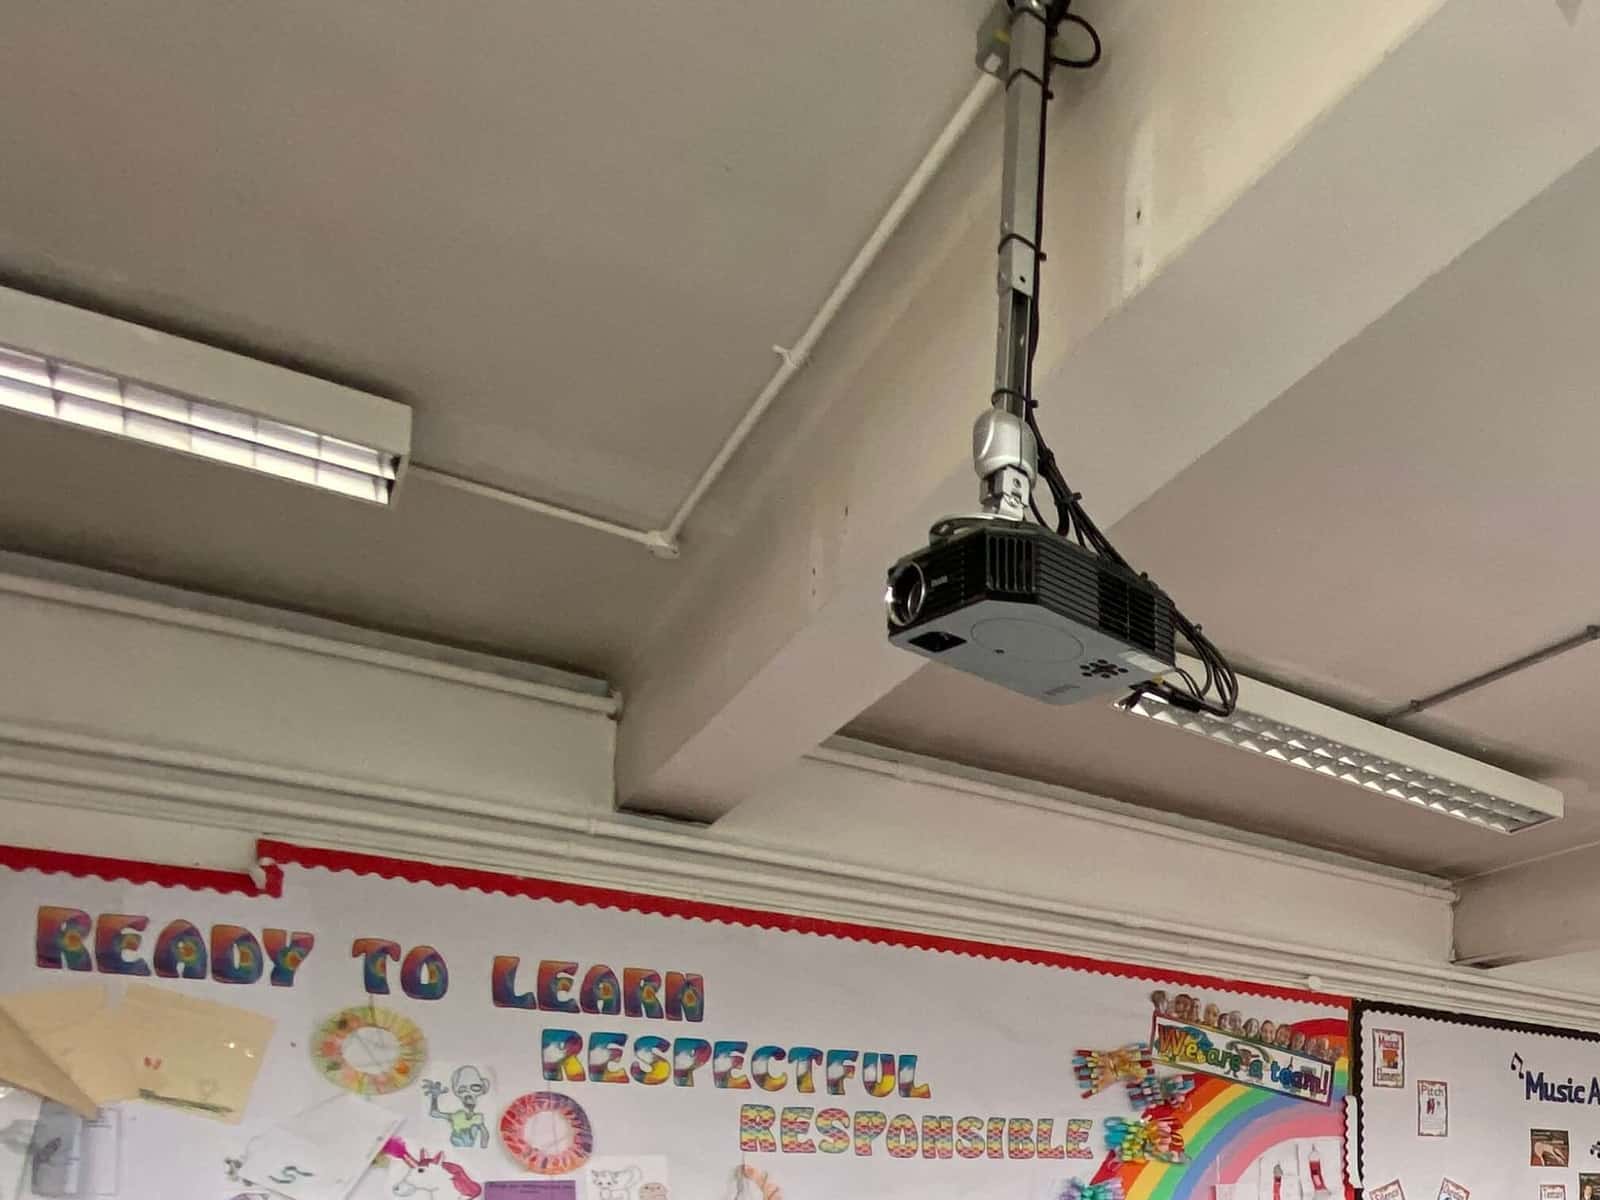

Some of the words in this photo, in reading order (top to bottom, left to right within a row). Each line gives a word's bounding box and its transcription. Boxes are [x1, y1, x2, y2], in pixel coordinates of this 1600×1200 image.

[35, 905, 314, 988] READY
[351, 937, 449, 1001] TO
[491, 954, 704, 1023] LEARN
[540, 1027, 931, 1100] RESPECTFUL
[1157, 1024, 1198, 1061] We
[1207, 1047, 1242, 1073] are
[1249, 1059, 1264, 1079] a
[1271, 1060, 1329, 1096] team!
[1420, 1084, 1445, 1097] Pitch
[1525, 1070, 1586, 1104] Music
[739, 1103, 1095, 1160] RESPONSIBLE
